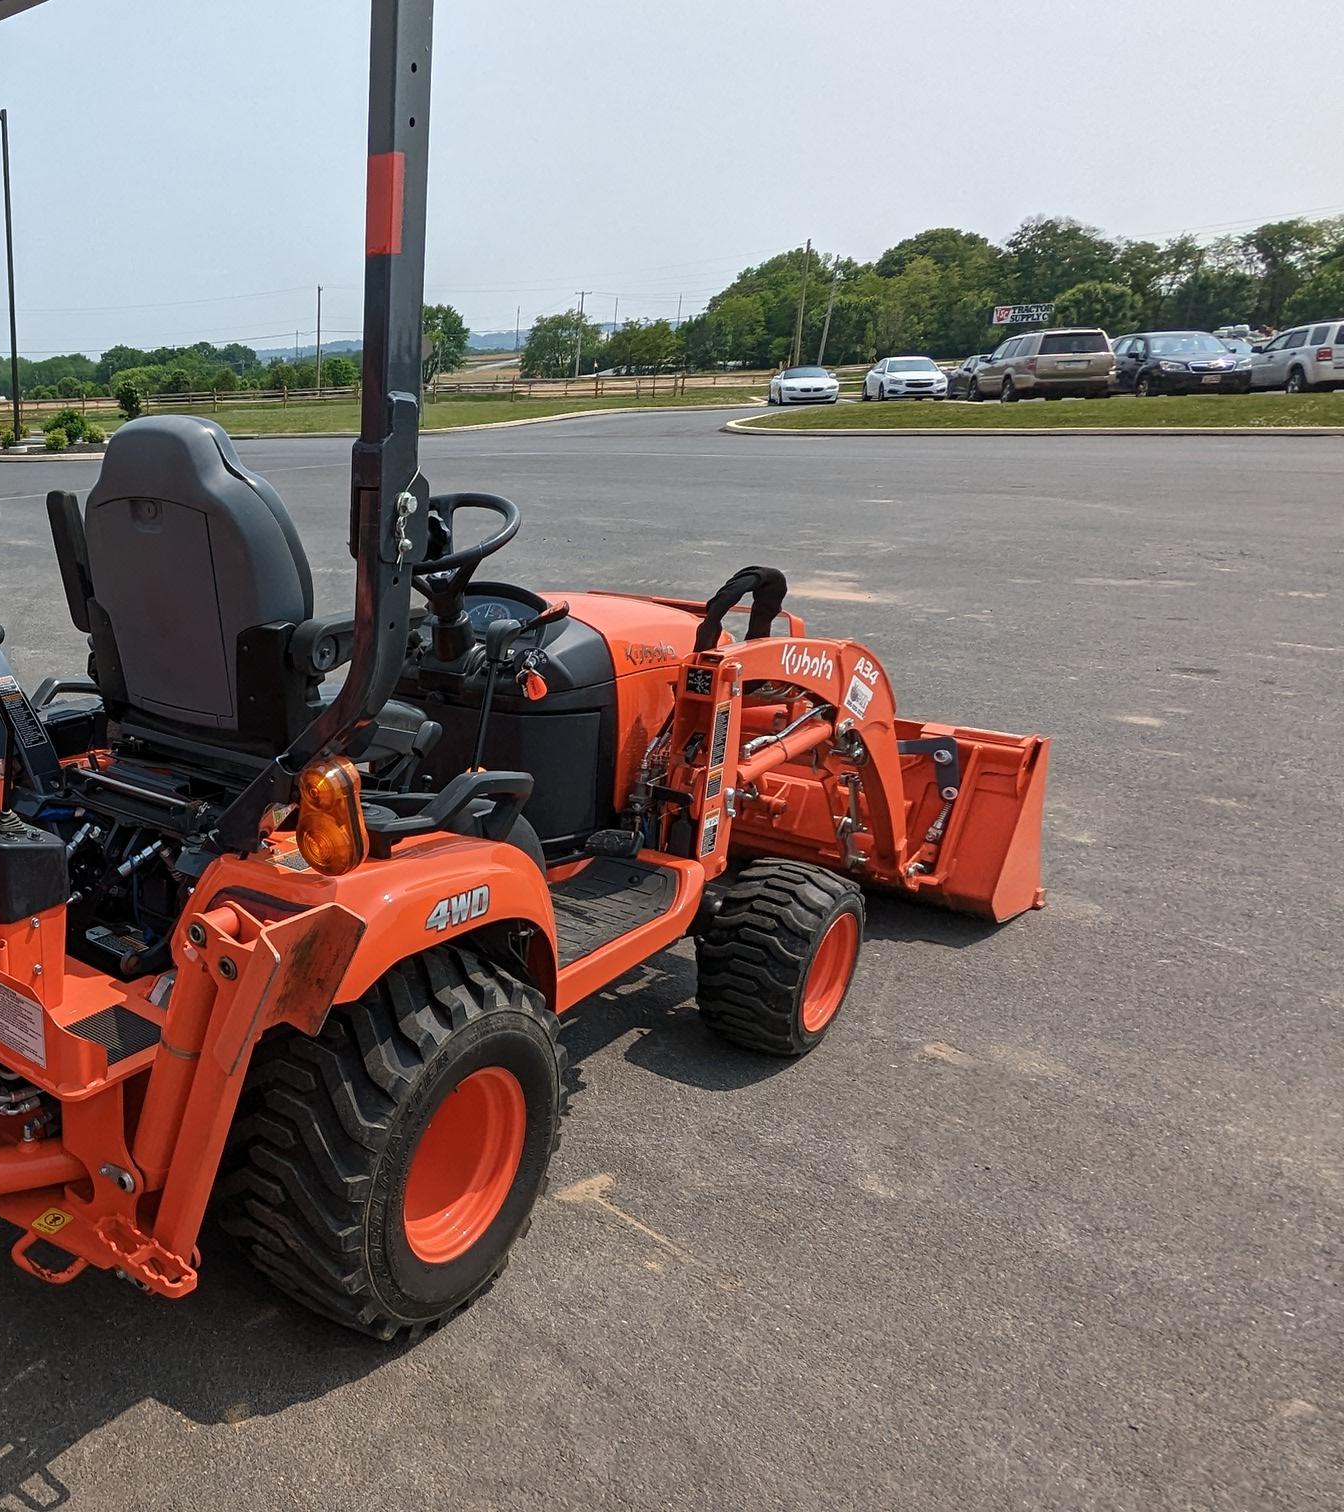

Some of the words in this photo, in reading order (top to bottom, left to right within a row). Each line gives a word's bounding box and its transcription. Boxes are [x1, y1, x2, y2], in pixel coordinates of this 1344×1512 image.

[1010, 313, 1041, 322] SUPPLY
[1011, 304, 1054, 314] TRACTOR
[781, 643, 834, 681] Kubota
[854, 656, 880, 686] A34
[425, 884, 490, 932] 4WD
